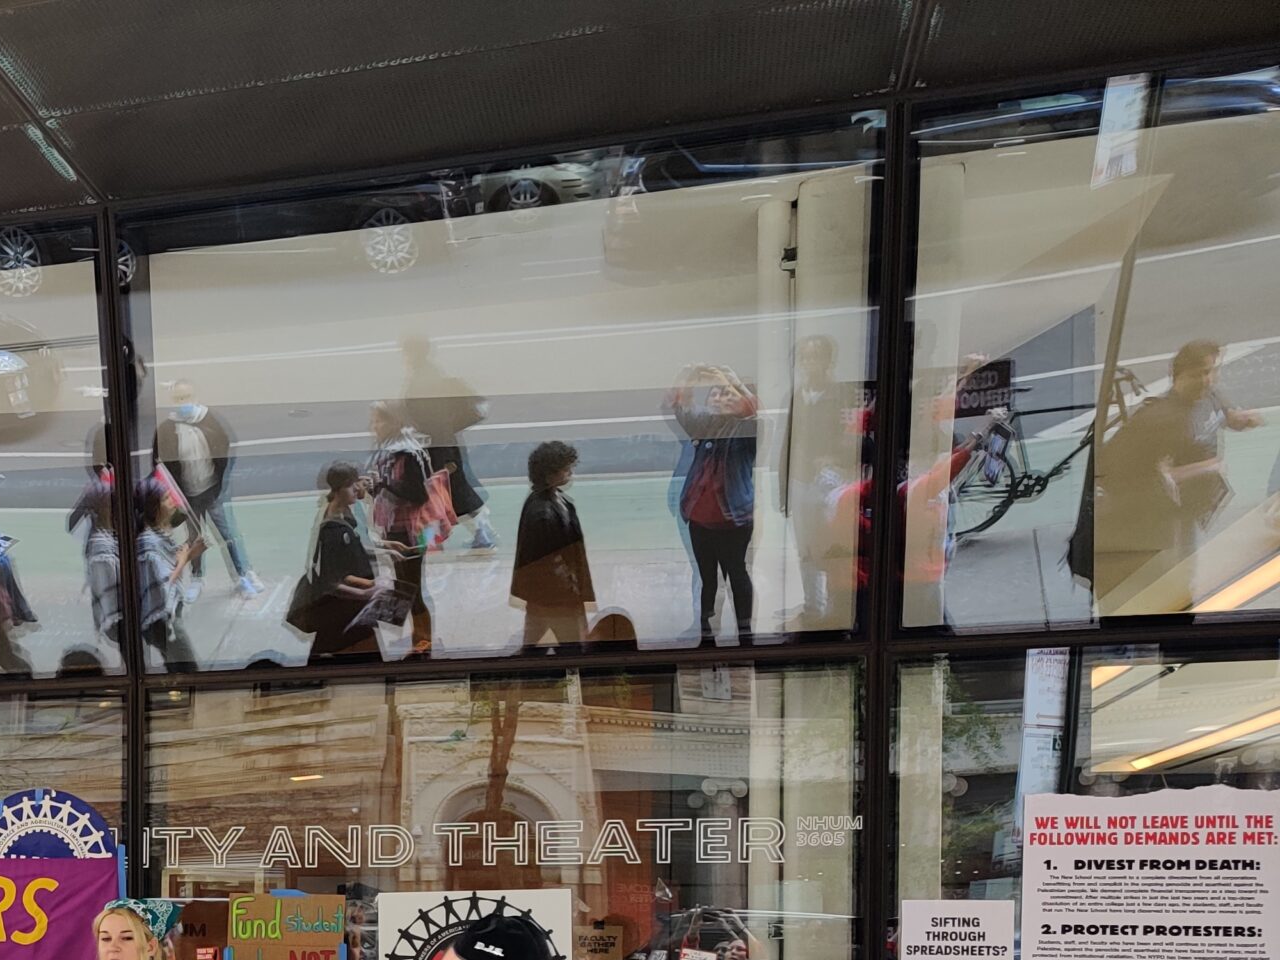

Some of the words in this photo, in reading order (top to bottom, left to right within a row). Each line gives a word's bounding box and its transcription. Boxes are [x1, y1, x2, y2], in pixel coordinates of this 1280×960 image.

[796, 815, 864, 831] NHUM
[1034, 816, 1059, 830] WE
[1064, 816, 1101, 830] WILL
[1107, 815, 1137, 829] NOT
[1142, 815, 1189, 829] LEAVE
[1194, 815, 1239, 829] UNTIL
[1245, 815, 1274, 829] THE
[259, 825, 415, 869] AND
[432, 816, 788, 866] THEATER
[1029, 832, 1118, 846] FOLLOWING
[1124, 832, 1200, 846] DEMANDS
[1205, 831, 1237, 845] ARE
[1242, 831, 1279, 845] MET:
[1043, 859, 1058, 871] 1.
[1073, 859, 1136, 871] DIVEST
[1138, 859, 1191, 871] FROM
[1195, 859, 1262, 871] DEATH:
[231, 895, 283, 941] Fund
[931, 917, 981, 928] SIFTING
[925, 931, 986, 942] THROUGH
[1041, 924, 1057, 936] 2.
[1060, 924, 1139, 937] PROTECT
[1142, 925, 1263, 938] PROTESTERS:
[906, 945, 1008, 957] SPREADSHEETS?
